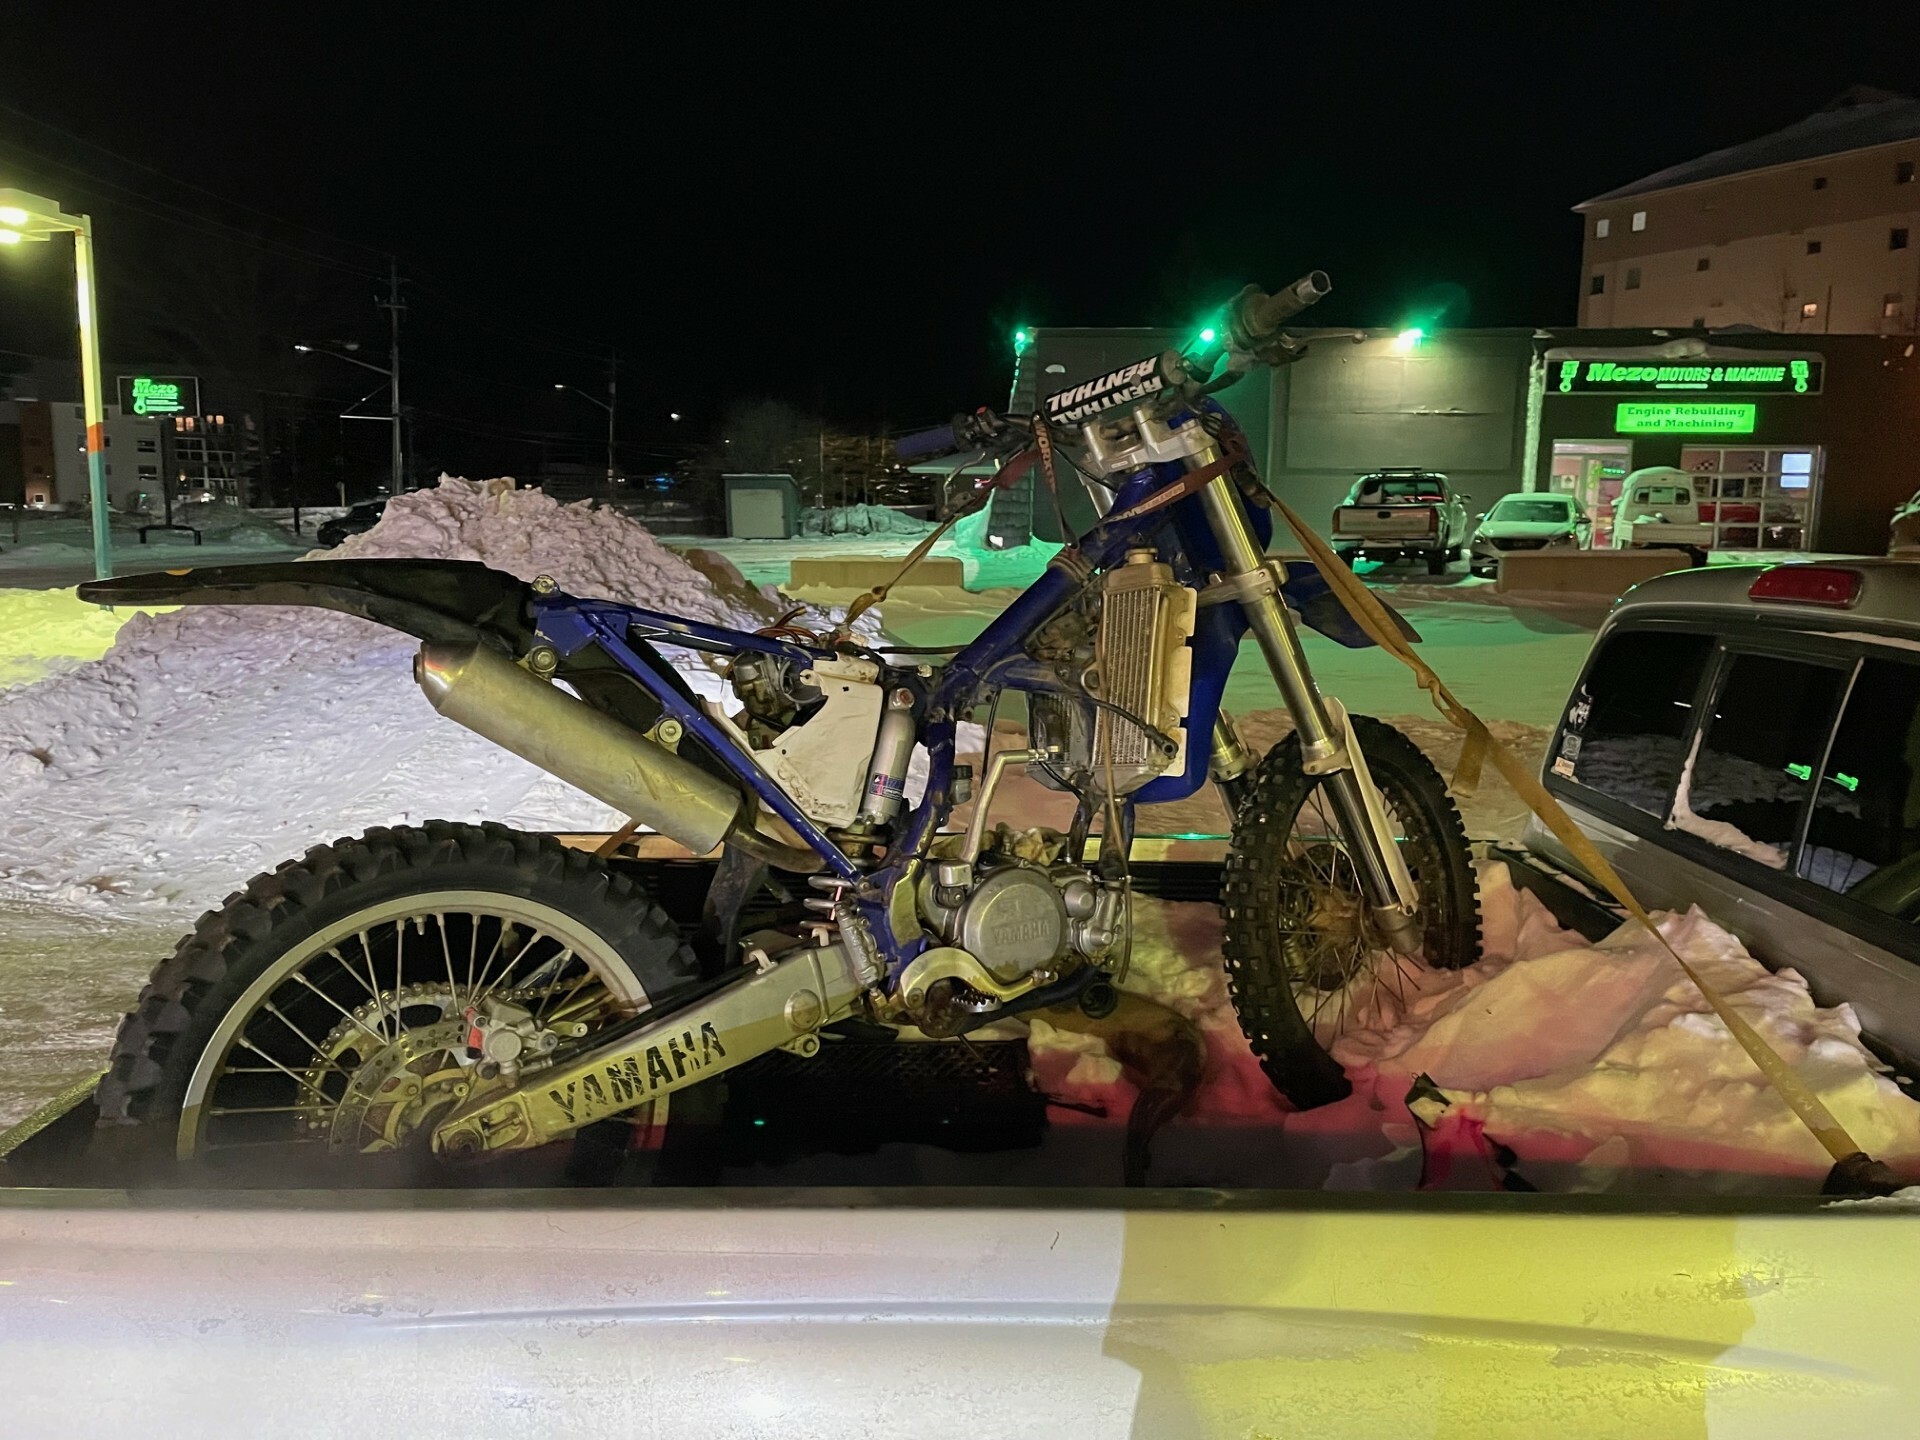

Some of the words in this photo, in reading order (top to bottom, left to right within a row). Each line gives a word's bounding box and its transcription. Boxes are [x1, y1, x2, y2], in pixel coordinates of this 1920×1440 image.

[1046, 356, 1158, 413] RENTHAL
[1586, 363, 1658, 381] Mezo
[1657, 367, 1711, 381] MOTORS
[1711, 367, 1723, 381] &
[1724, 367, 1786, 381] MACHINE
[1051, 375, 1163, 425] RENTHAL
[1627, 406, 1671, 417] Engine
[1675, 406, 1746, 418] Rebuilding
[1636, 419, 1661, 428] and
[1665, 419, 1735, 430] Machining
[990, 917, 1051, 947] YAMAHA
[548, 1021, 727, 1124] YAMAHA
